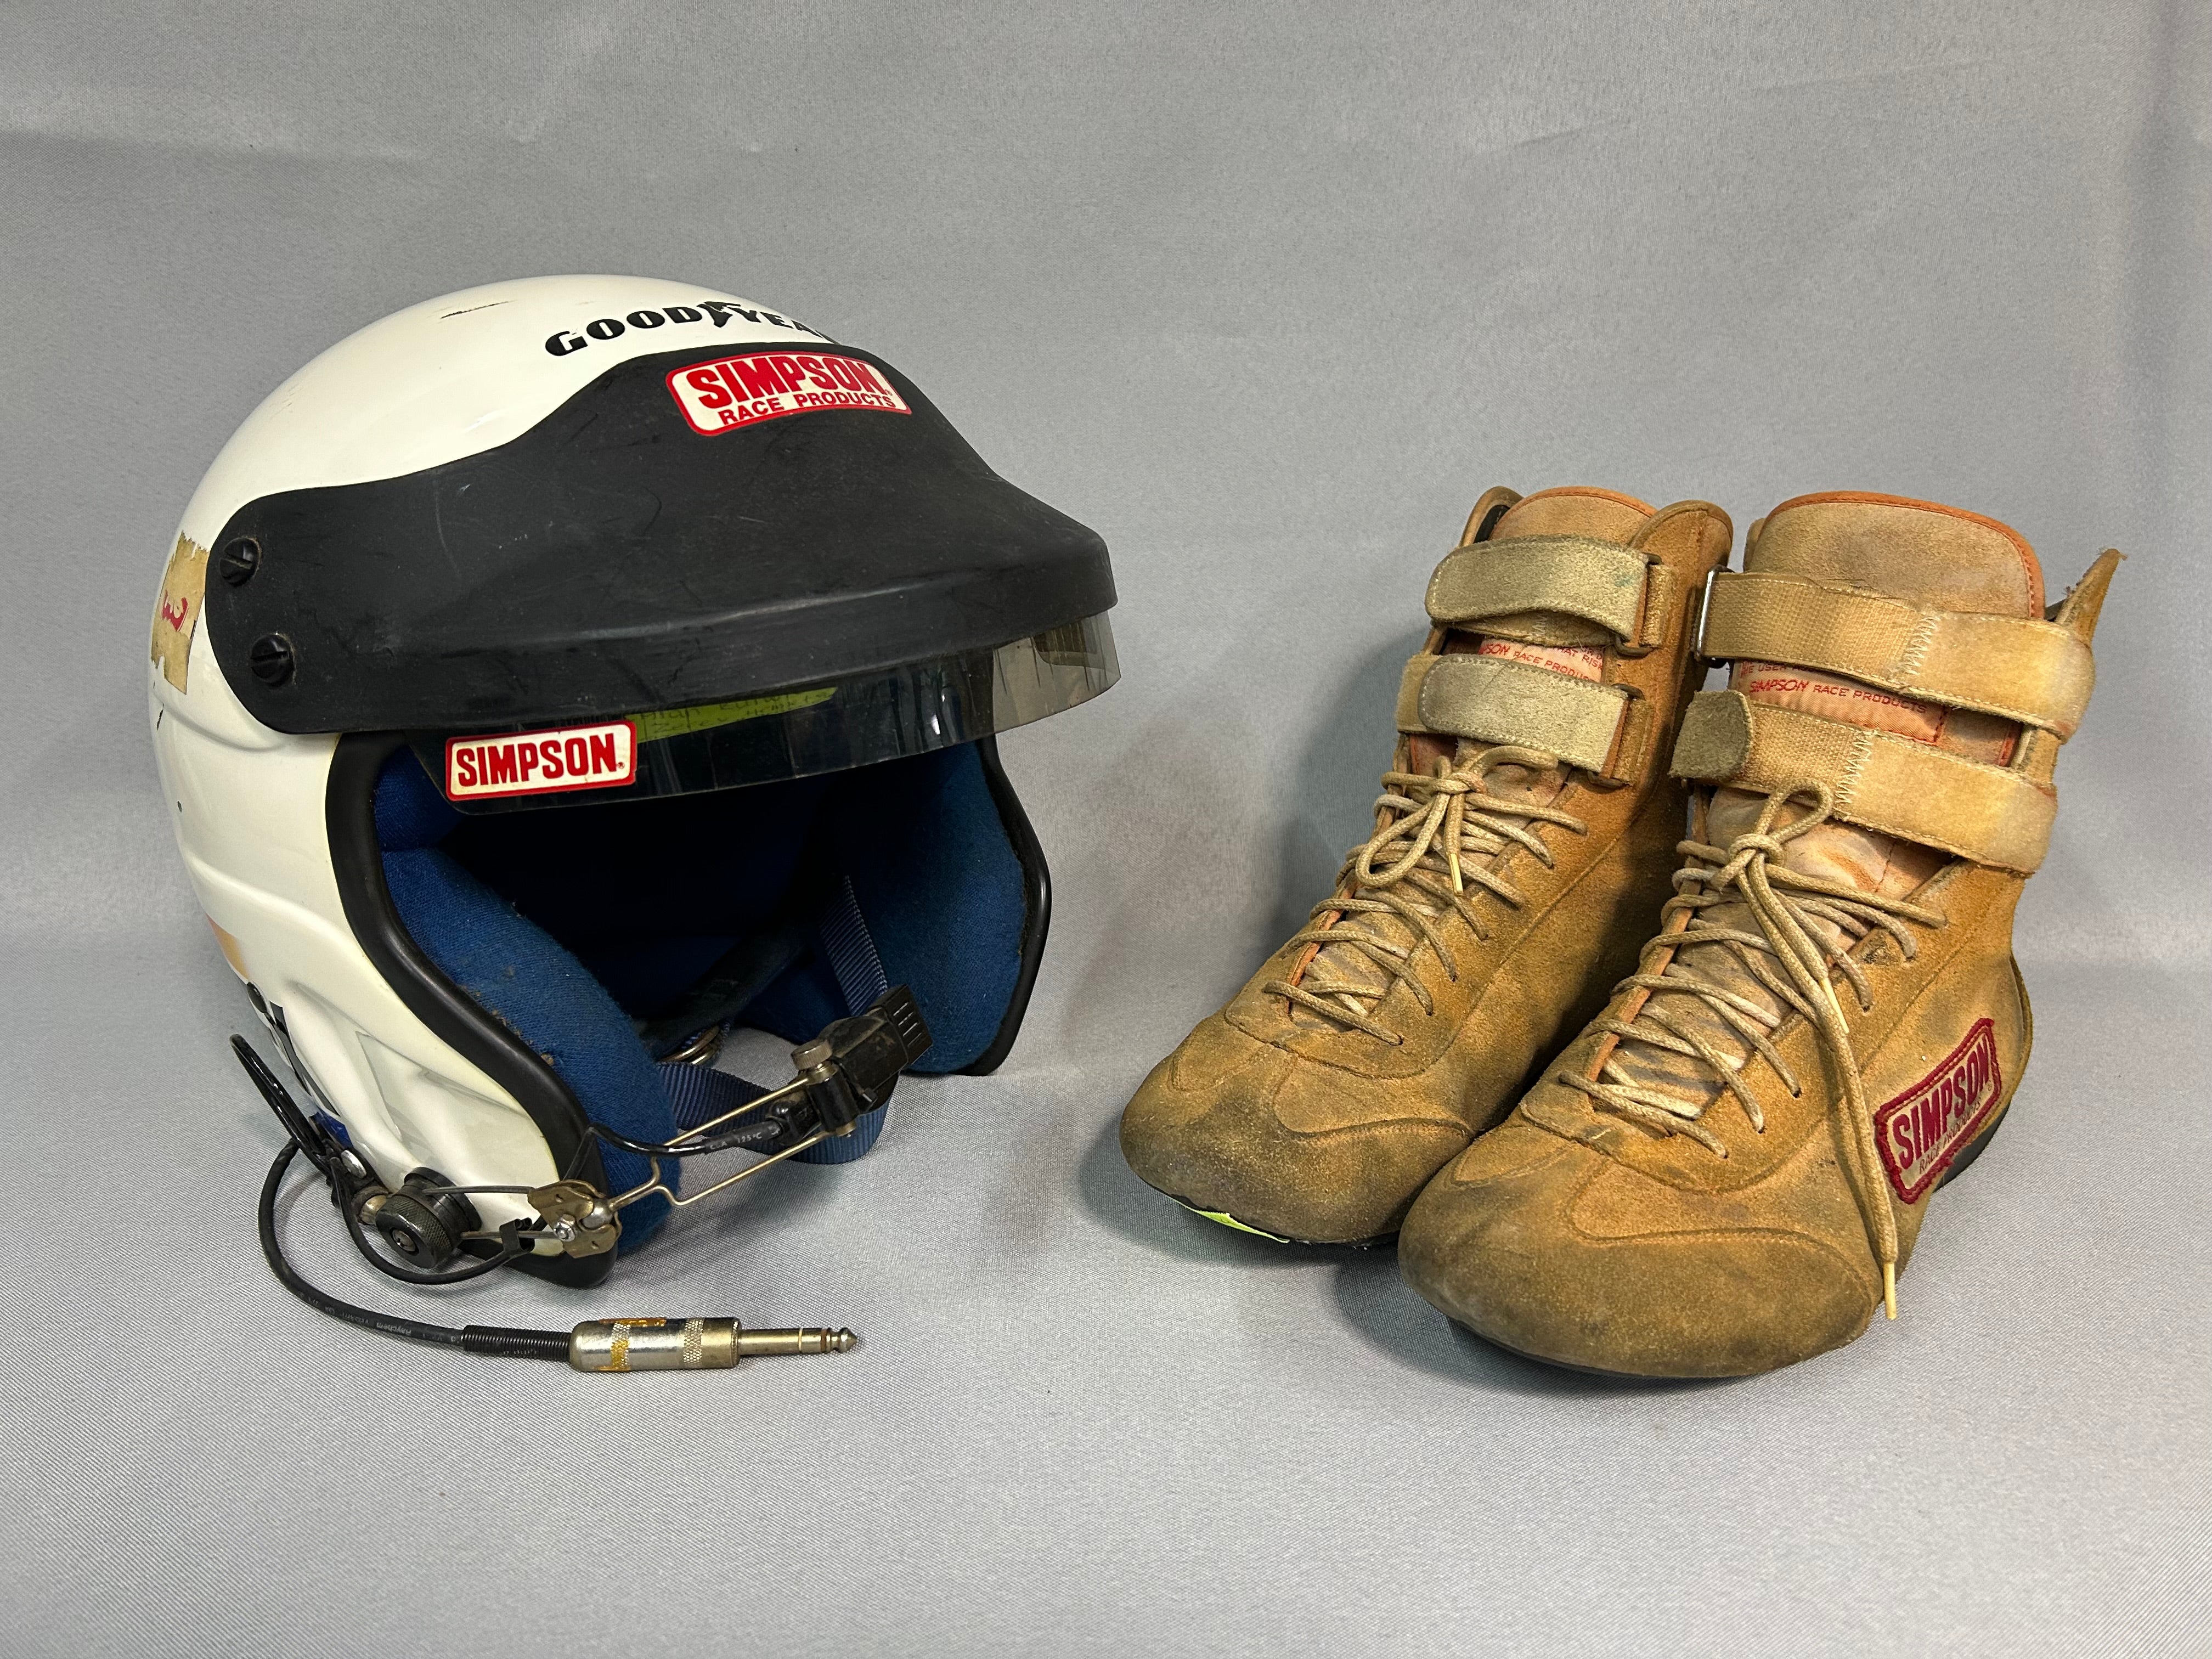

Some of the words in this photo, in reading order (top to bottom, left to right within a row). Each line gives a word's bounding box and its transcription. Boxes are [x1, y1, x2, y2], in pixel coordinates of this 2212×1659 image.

[545, 301, 840, 357] GOODYEA
[686, 356, 887, 409] SIMPSON
[717, 397, 785, 425] RACE
[793, 392, 896, 408] PRODUCTS
[1513, 651, 1543, 664] RACE
[1749, 679, 1809, 693] SIMPSON
[1813, 684, 1848, 697] RACE
[1853, 690, 1927, 714] PRODUCTS
[456, 733, 617, 787] SIMPSON
[1892, 1033, 1989, 1170] SIMPSON
